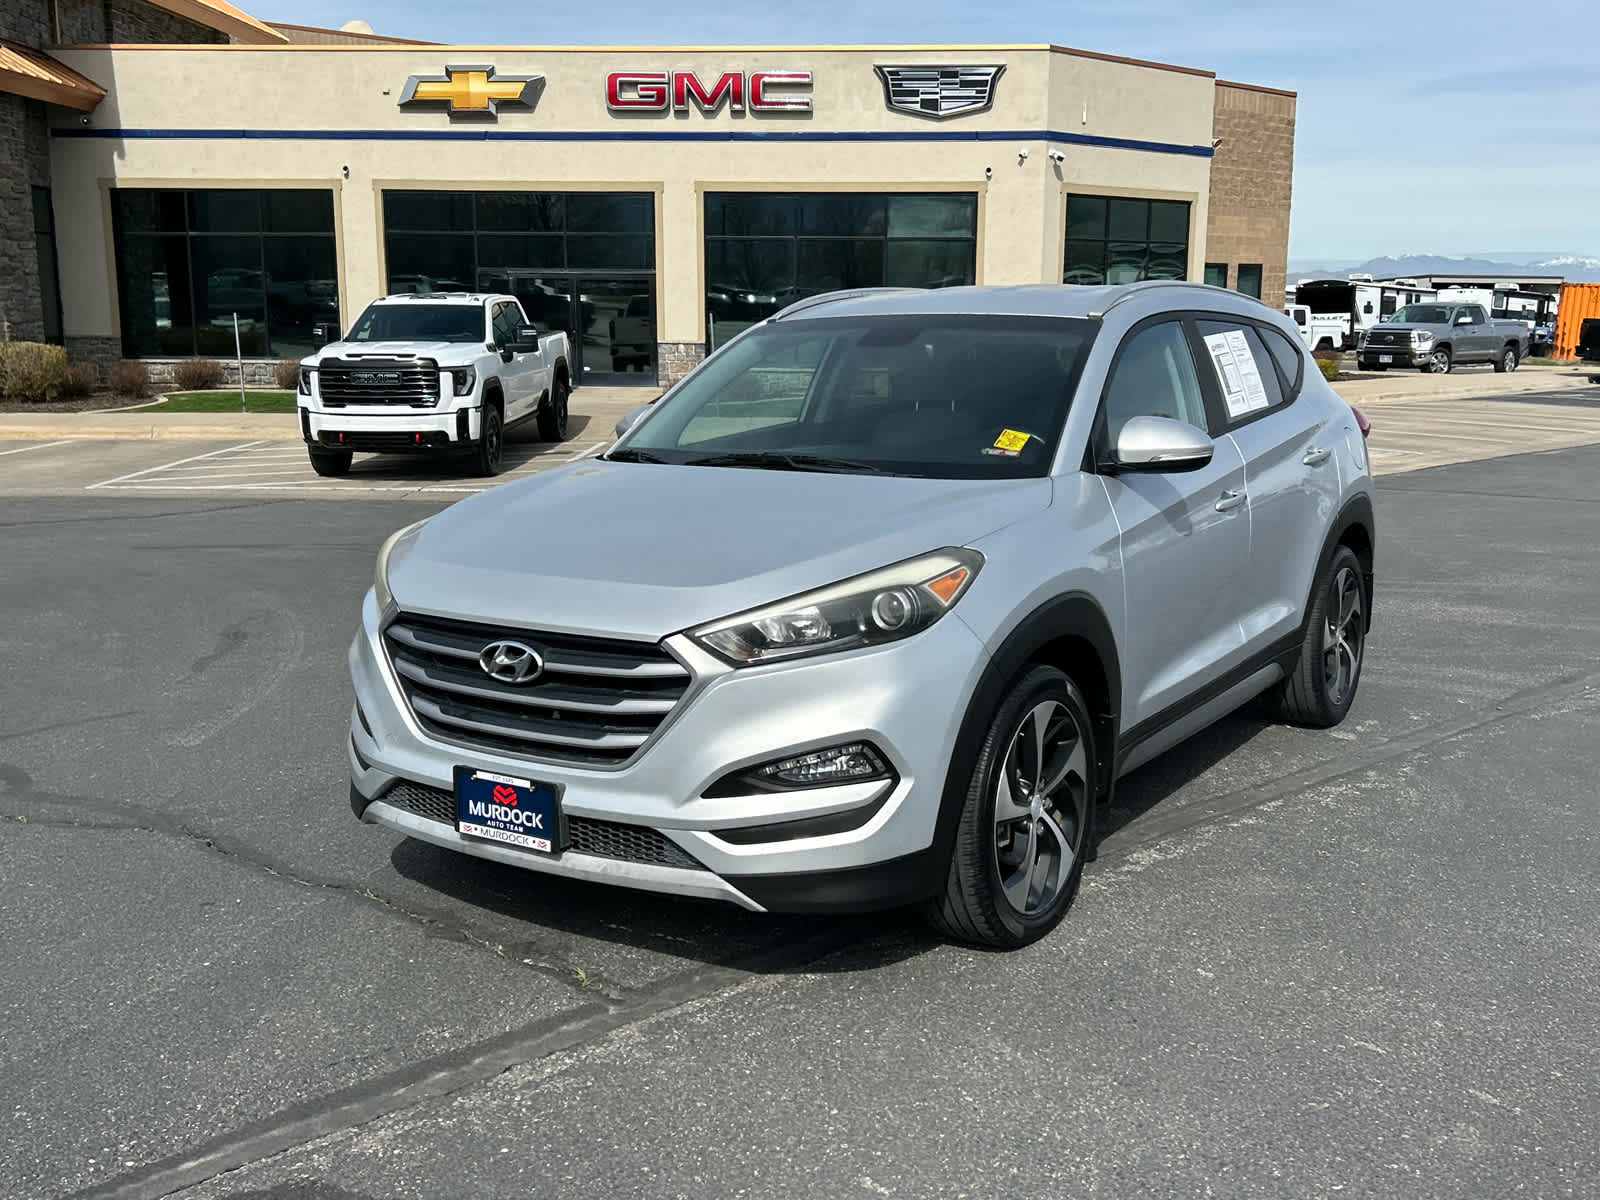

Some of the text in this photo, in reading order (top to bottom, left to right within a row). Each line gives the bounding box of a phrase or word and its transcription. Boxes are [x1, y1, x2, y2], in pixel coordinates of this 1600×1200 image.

[606, 70, 813, 112] GMC
[468, 799, 543, 829] MURDOCK
[479, 827, 529, 846] MURDOCK
[487, 820, 524, 833] AUTO TEAM
